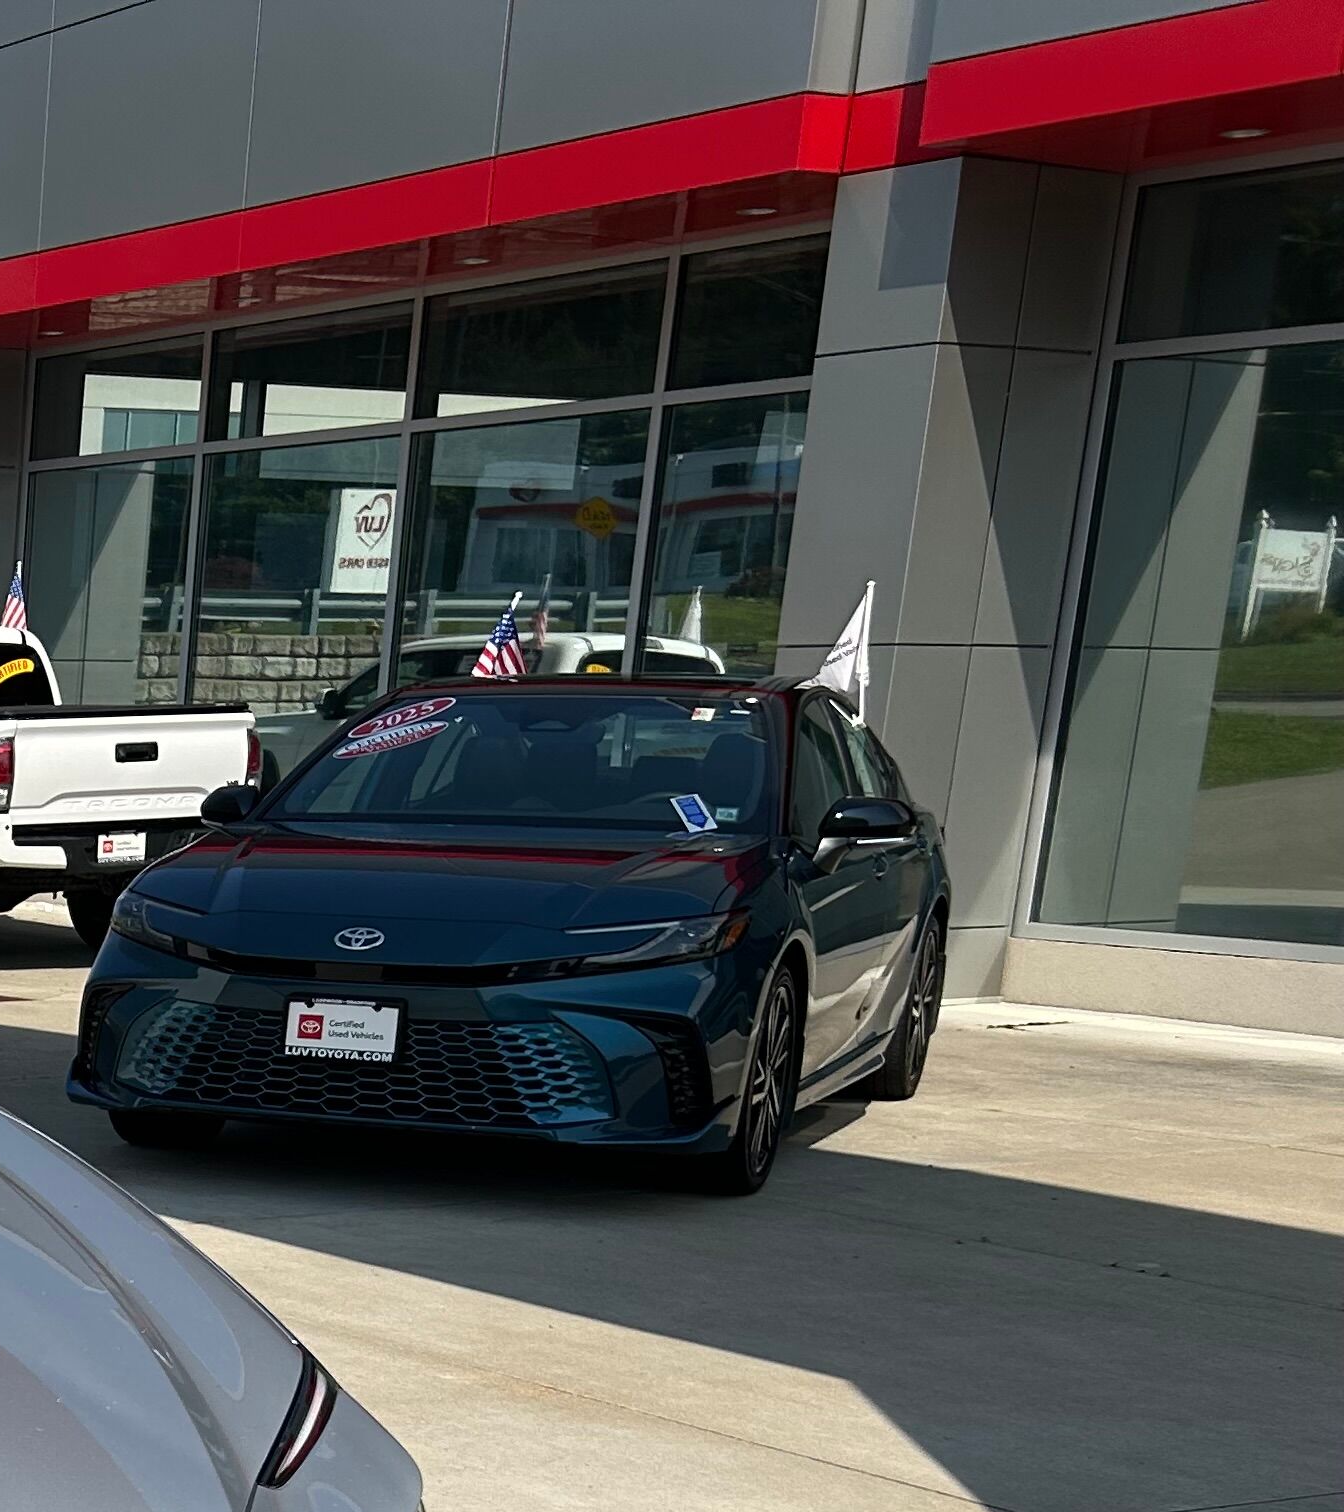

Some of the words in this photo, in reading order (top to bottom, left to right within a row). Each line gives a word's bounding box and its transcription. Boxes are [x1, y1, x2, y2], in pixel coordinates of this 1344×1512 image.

[369, 701, 436, 732] 2025
[67, 796, 196, 810] TACOMA
[328, 1020, 365, 1029] Certified
[328, 1030, 349, 1038] Used
[350, 1032, 384, 1041] Vehicles
[285, 1046, 393, 1062] LUVTOYOTA.COM
